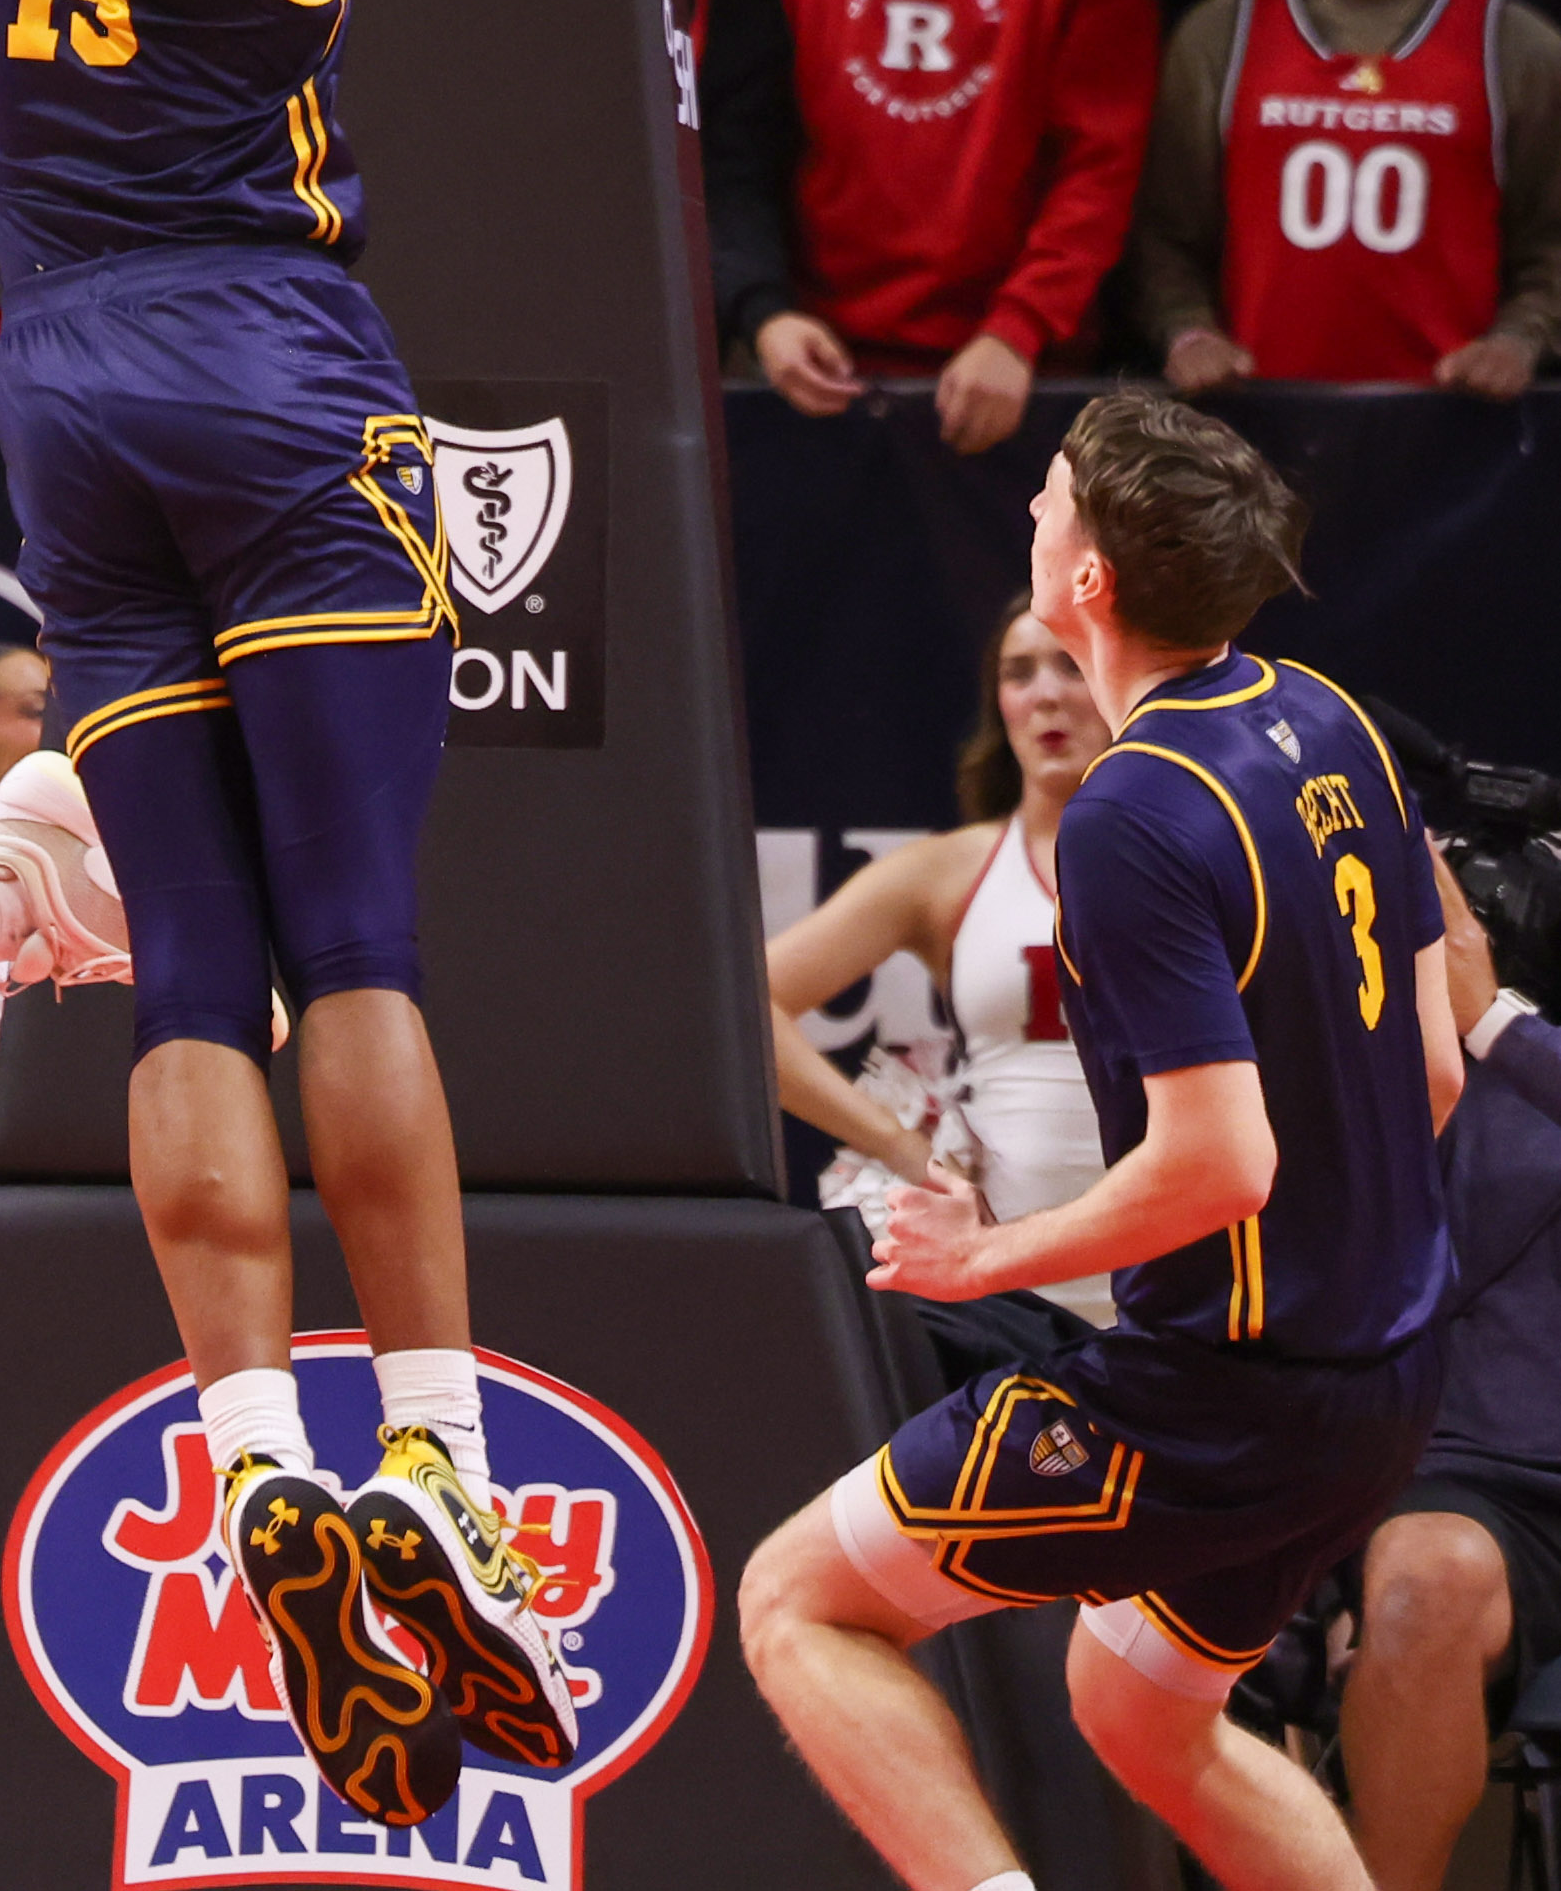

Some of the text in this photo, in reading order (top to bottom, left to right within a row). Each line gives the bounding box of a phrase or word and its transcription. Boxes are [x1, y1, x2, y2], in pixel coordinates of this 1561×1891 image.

[1259, 94, 1459, 136] RUTGERS
[1279, 140, 1429, 254] 00
[1333, 853, 1386, 1031] 3
